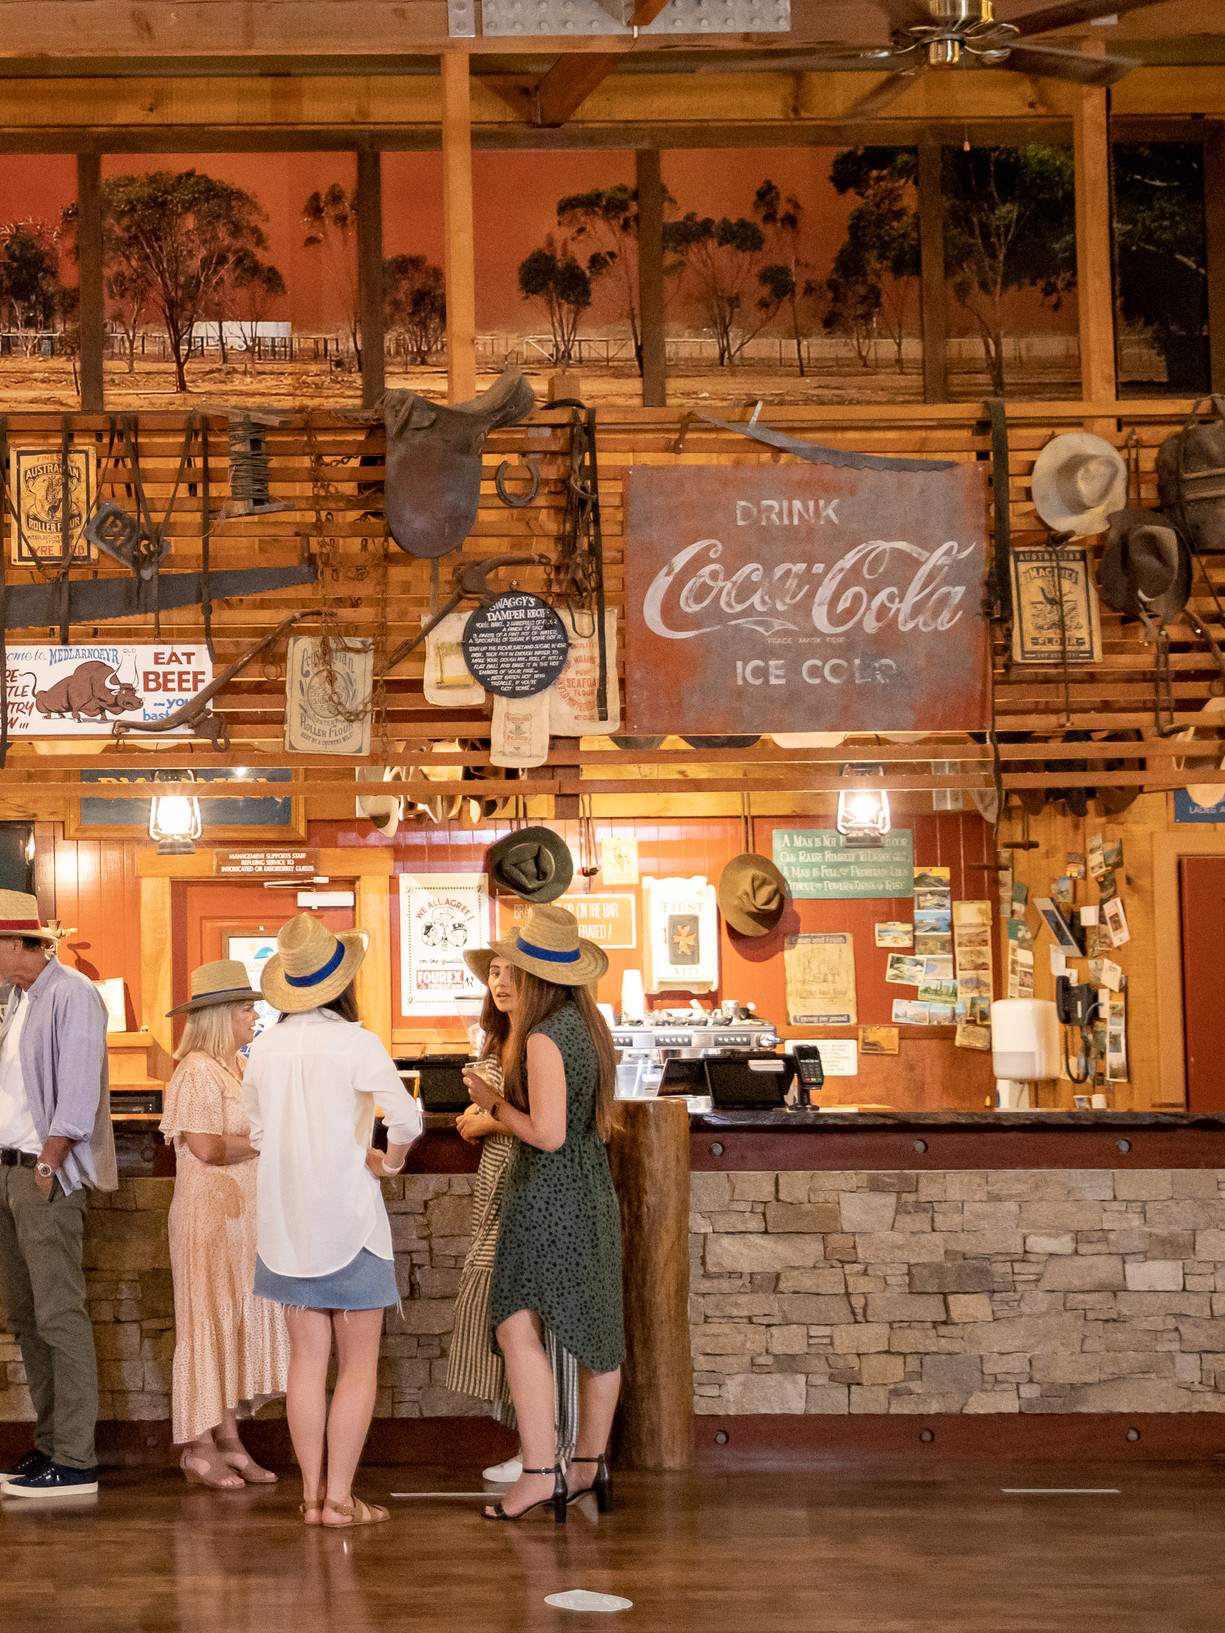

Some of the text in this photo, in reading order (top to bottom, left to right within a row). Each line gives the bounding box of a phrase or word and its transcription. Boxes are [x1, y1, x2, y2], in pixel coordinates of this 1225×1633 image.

[25, 464, 80, 481] AUSTRAAN
[735, 499, 840, 526] DRINK
[28, 516, 80, 532] ROLLER FUR
[486, 609, 525, 621] DAMPER
[153, 652, 195, 665] EAT
[736, 659, 786, 686] ICE
[143, 671, 206, 692] BEEF
[566, 677, 599, 688] SEAFOA
[143, 709, 175, 721] bast
[300, 713, 354, 738] ROLLER FLOUR
[784, 834, 791, 847] A
[783, 866, 790, 878] A
[415, 906, 427, 919] WE
[428, 898, 443, 909] ALL
[576, 903, 587, 918] ON
[588, 903, 601, 918] THE
[603, 902, 619, 918] BAR
[662, 902, 704, 912] FIRST
[417, 970, 464, 983] FOUREX
[672, 967, 699, 976] AID
